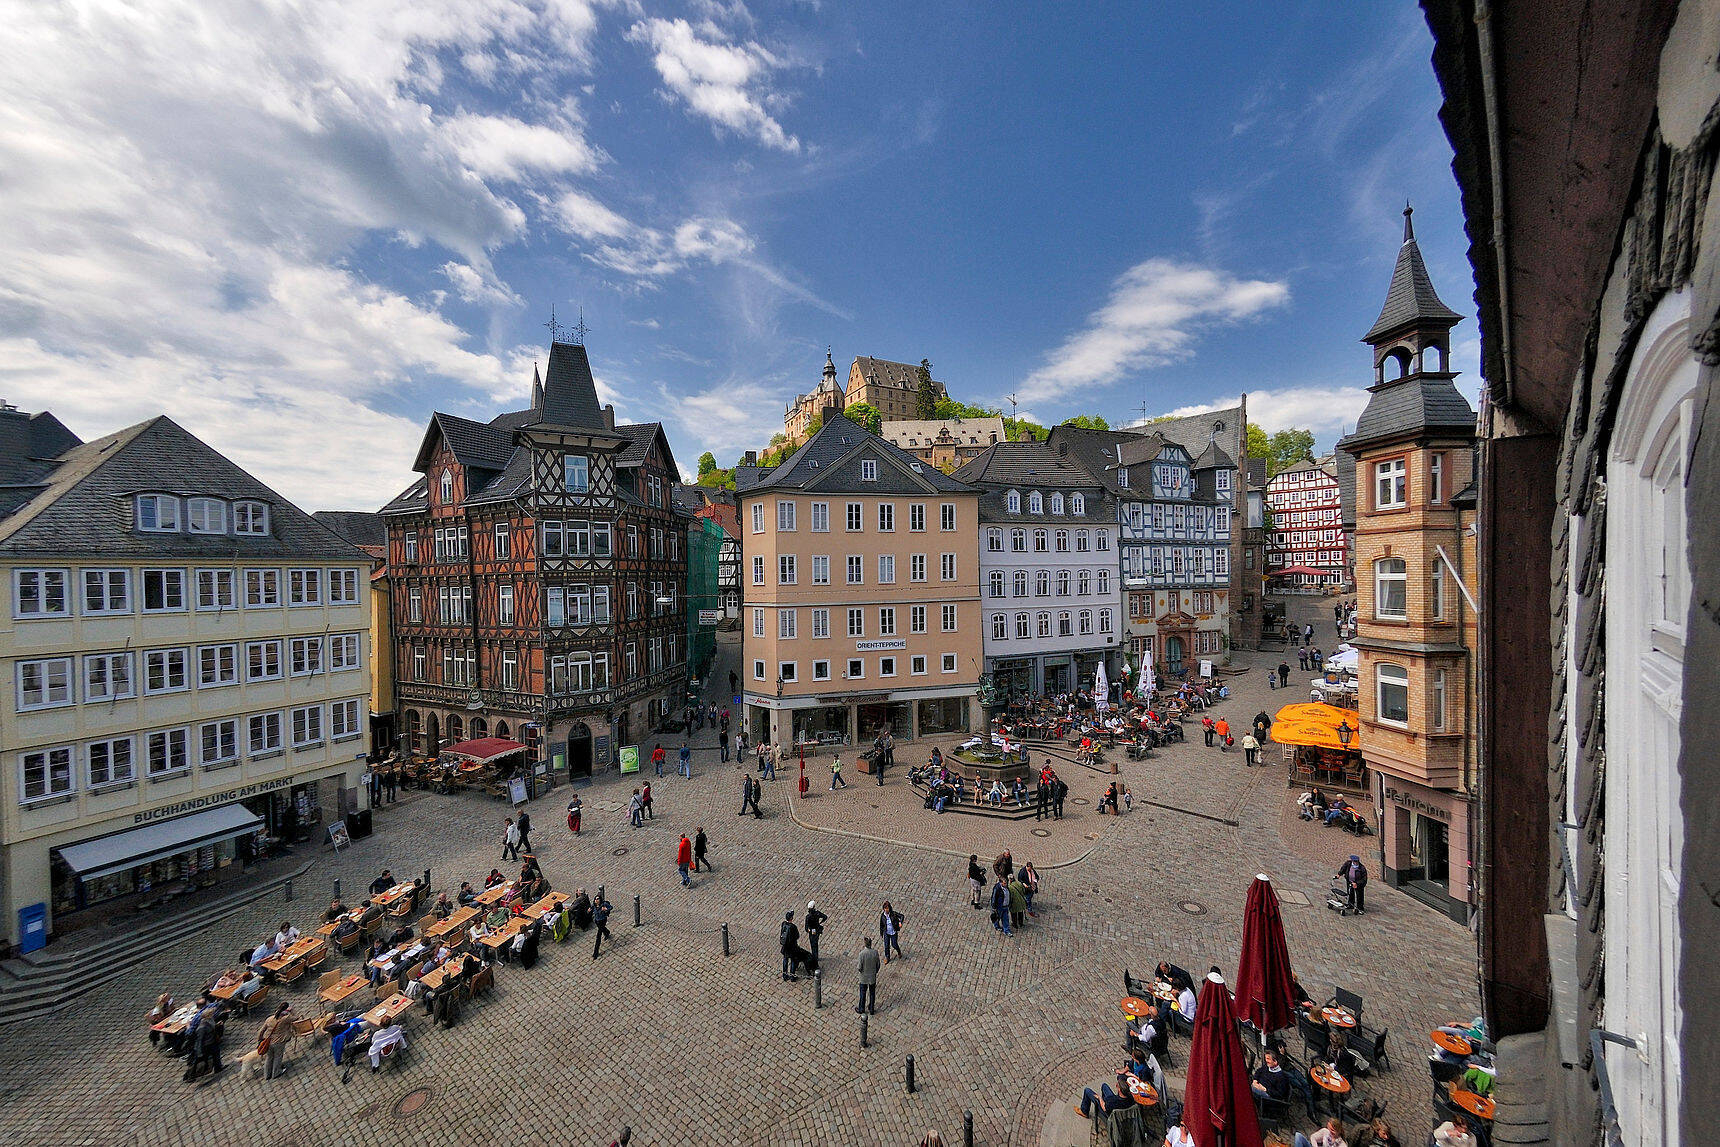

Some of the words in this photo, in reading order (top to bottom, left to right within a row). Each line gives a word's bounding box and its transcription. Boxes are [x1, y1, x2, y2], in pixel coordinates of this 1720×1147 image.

[857, 641, 906, 649] ORIENT-TEPPICHE
[134, 791, 237, 824] BUCHHANDLUNG
[240, 785, 256, 797] AM
[260, 776, 294, 791] MARKT
